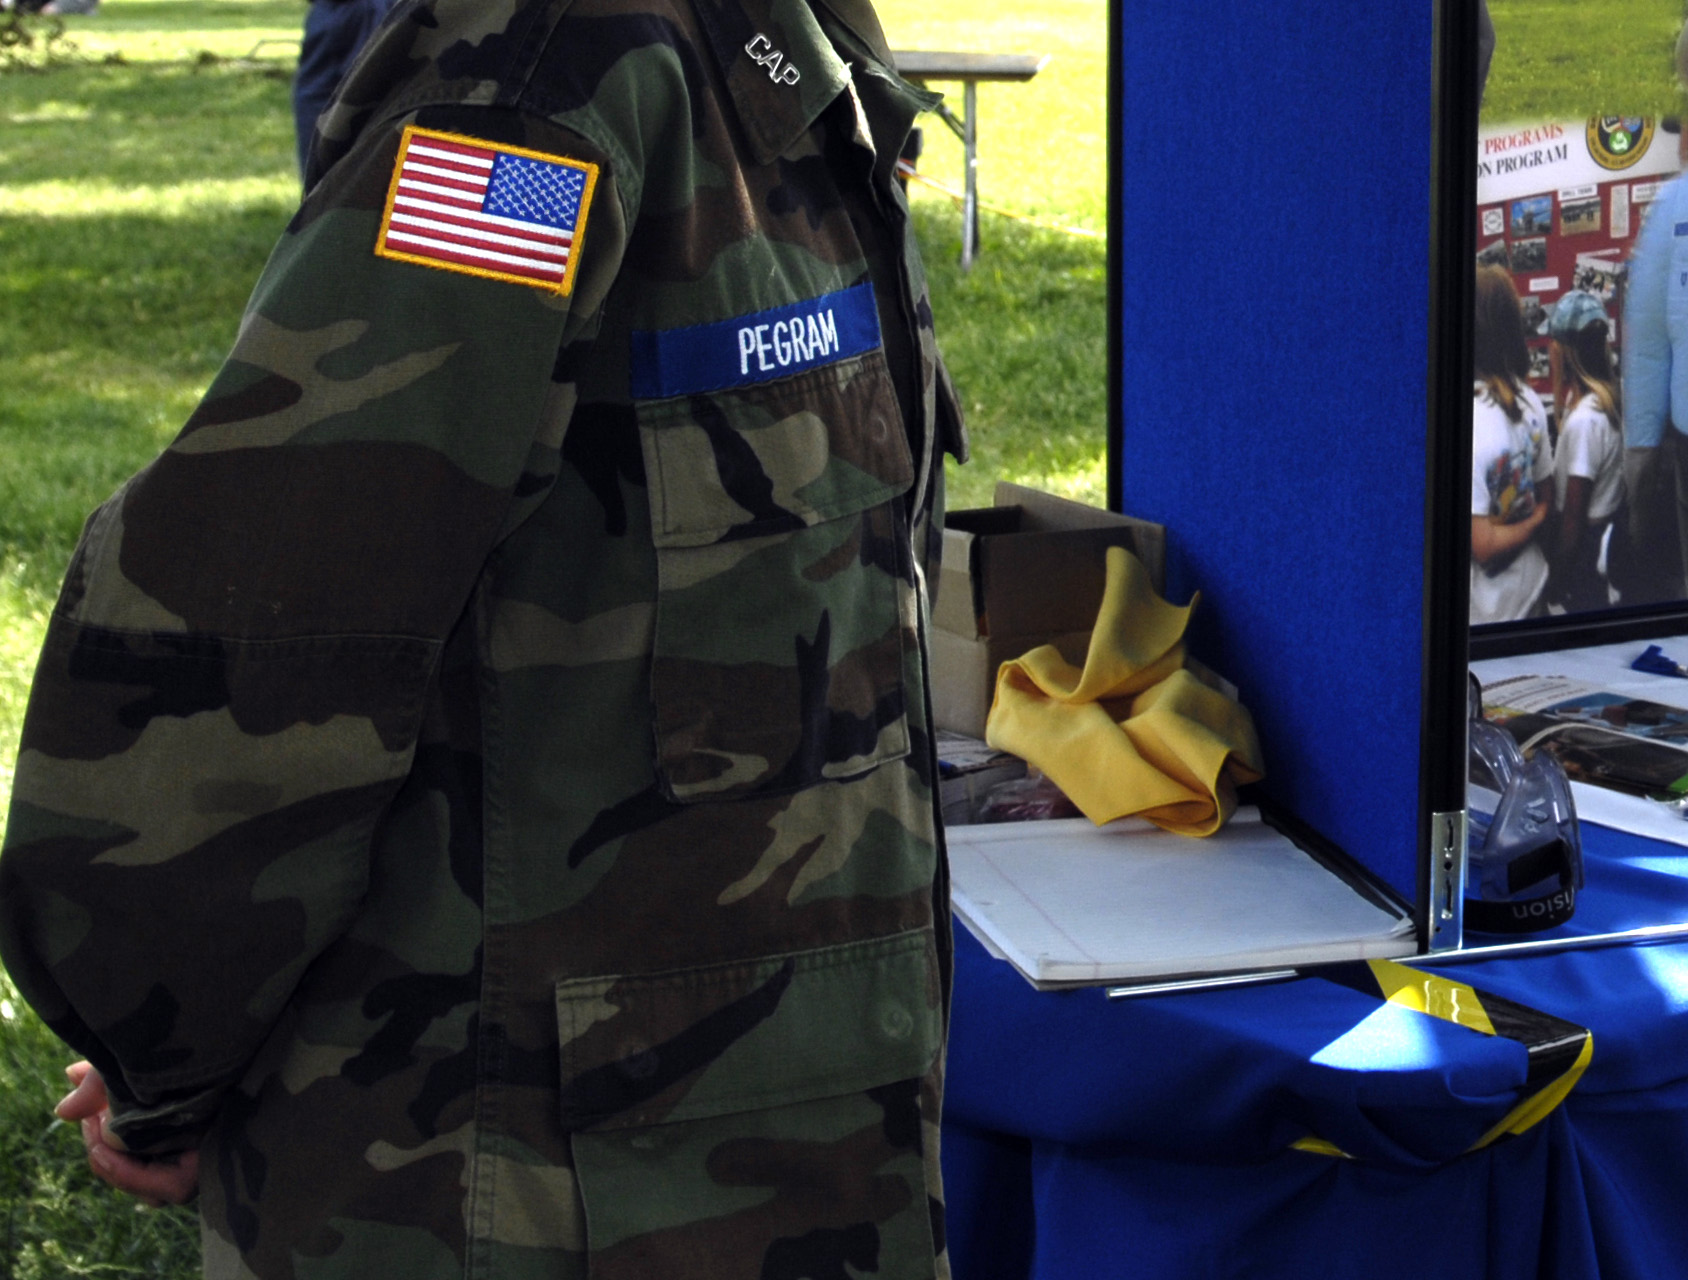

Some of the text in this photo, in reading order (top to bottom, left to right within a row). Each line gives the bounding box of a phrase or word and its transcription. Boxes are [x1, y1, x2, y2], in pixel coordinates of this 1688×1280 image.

[745, 33, 800, 85] CAP
[1485, 124, 1564, 155] PROGRAMS
[1496, 144, 1567, 175] PROGRAM
[738, 309, 838, 375] PEGRAM
